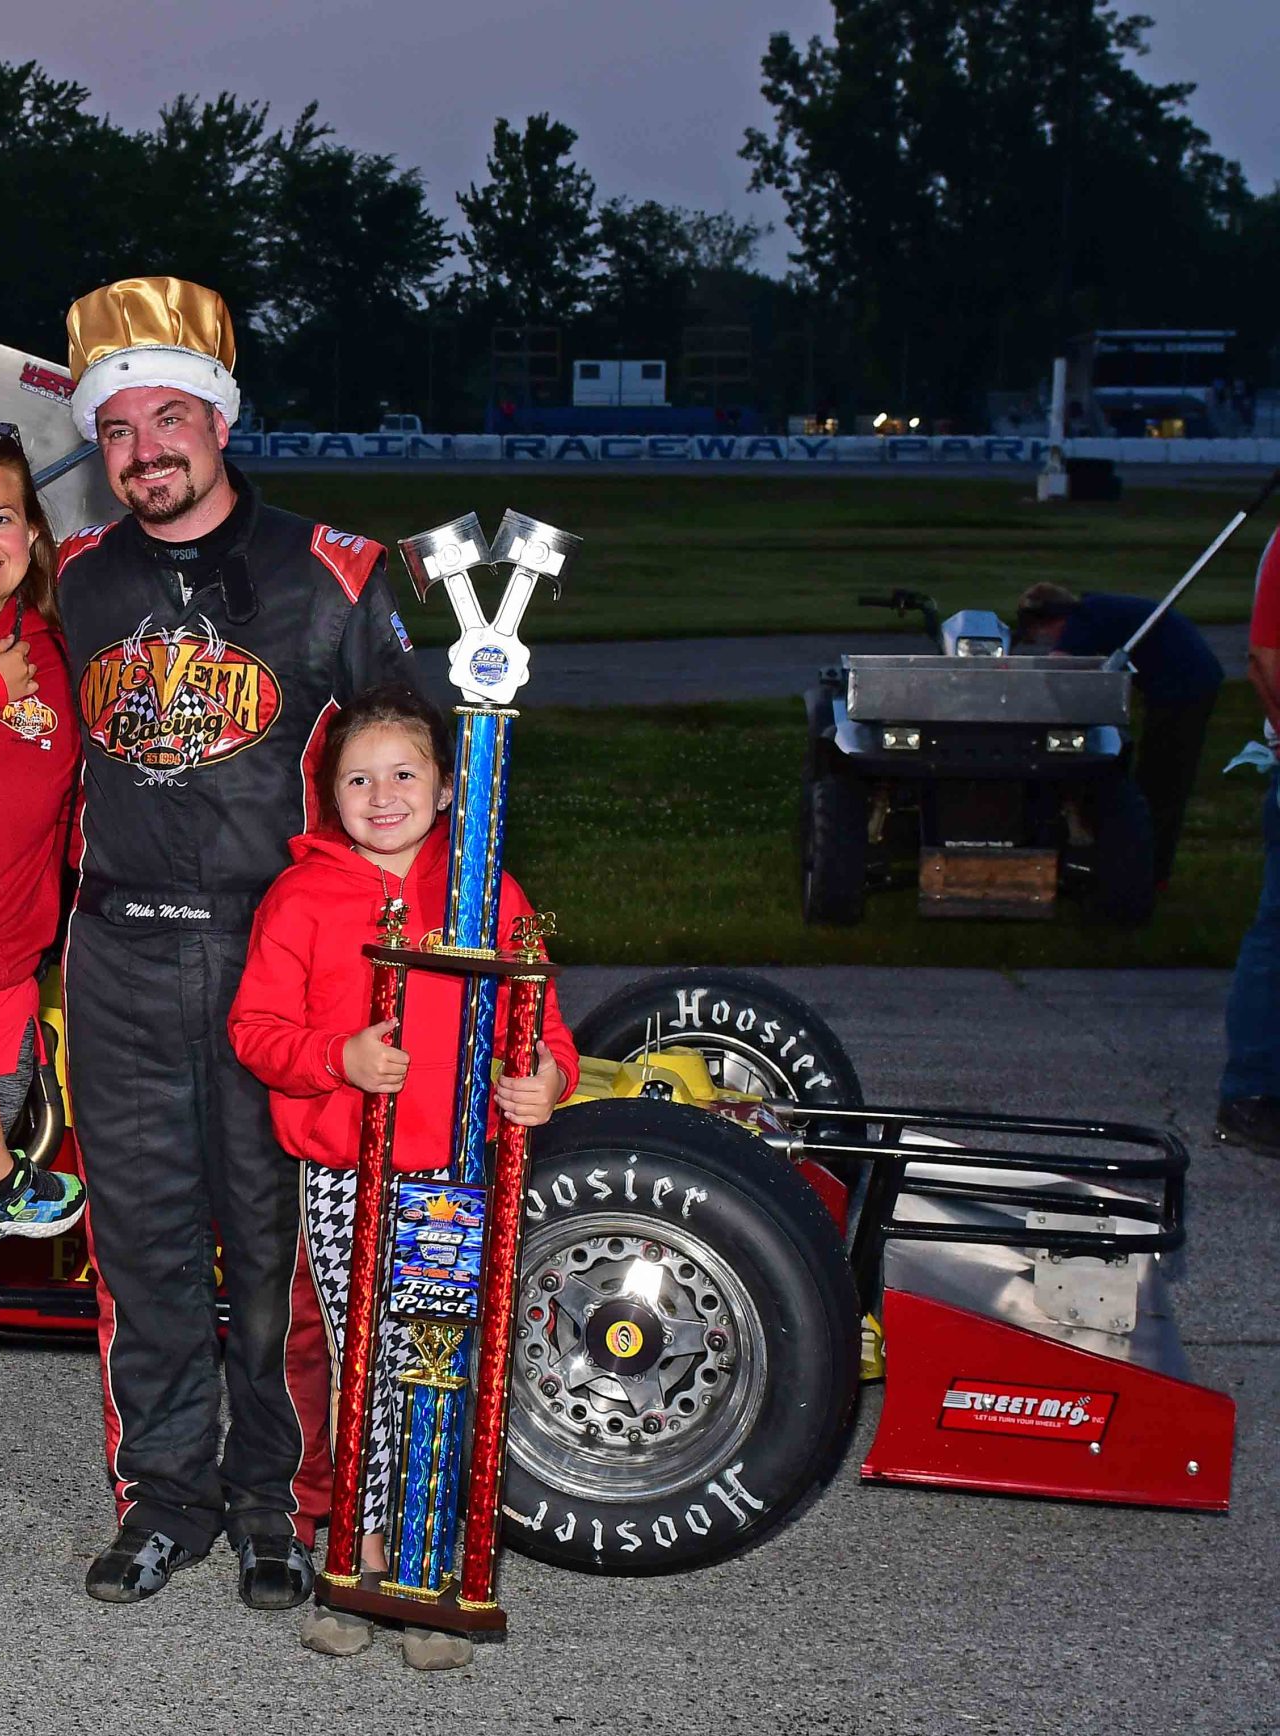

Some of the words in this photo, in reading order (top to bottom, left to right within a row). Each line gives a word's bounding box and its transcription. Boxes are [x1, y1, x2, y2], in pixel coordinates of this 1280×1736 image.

[505, 435, 831, 460] RACEWAY
[475, 651, 505, 662] 2023
[105, 710, 231, 752] Racing
[125, 902, 155, 917] Mike
[158, 904, 211, 919] McVetta
[669, 988, 833, 1090] Hoosier
[415, 1230, 464, 1245] 2023
[399, 1279, 471, 1299] FIRST
[395, 1294, 471, 1315] PLACE
[998, 1416, 1016, 1424] TURN
[1016, 1418, 1035, 1426] YOUR
[1091, 1416, 1105, 1425] INC
[523, 1461, 766, 1563] Hoosier
